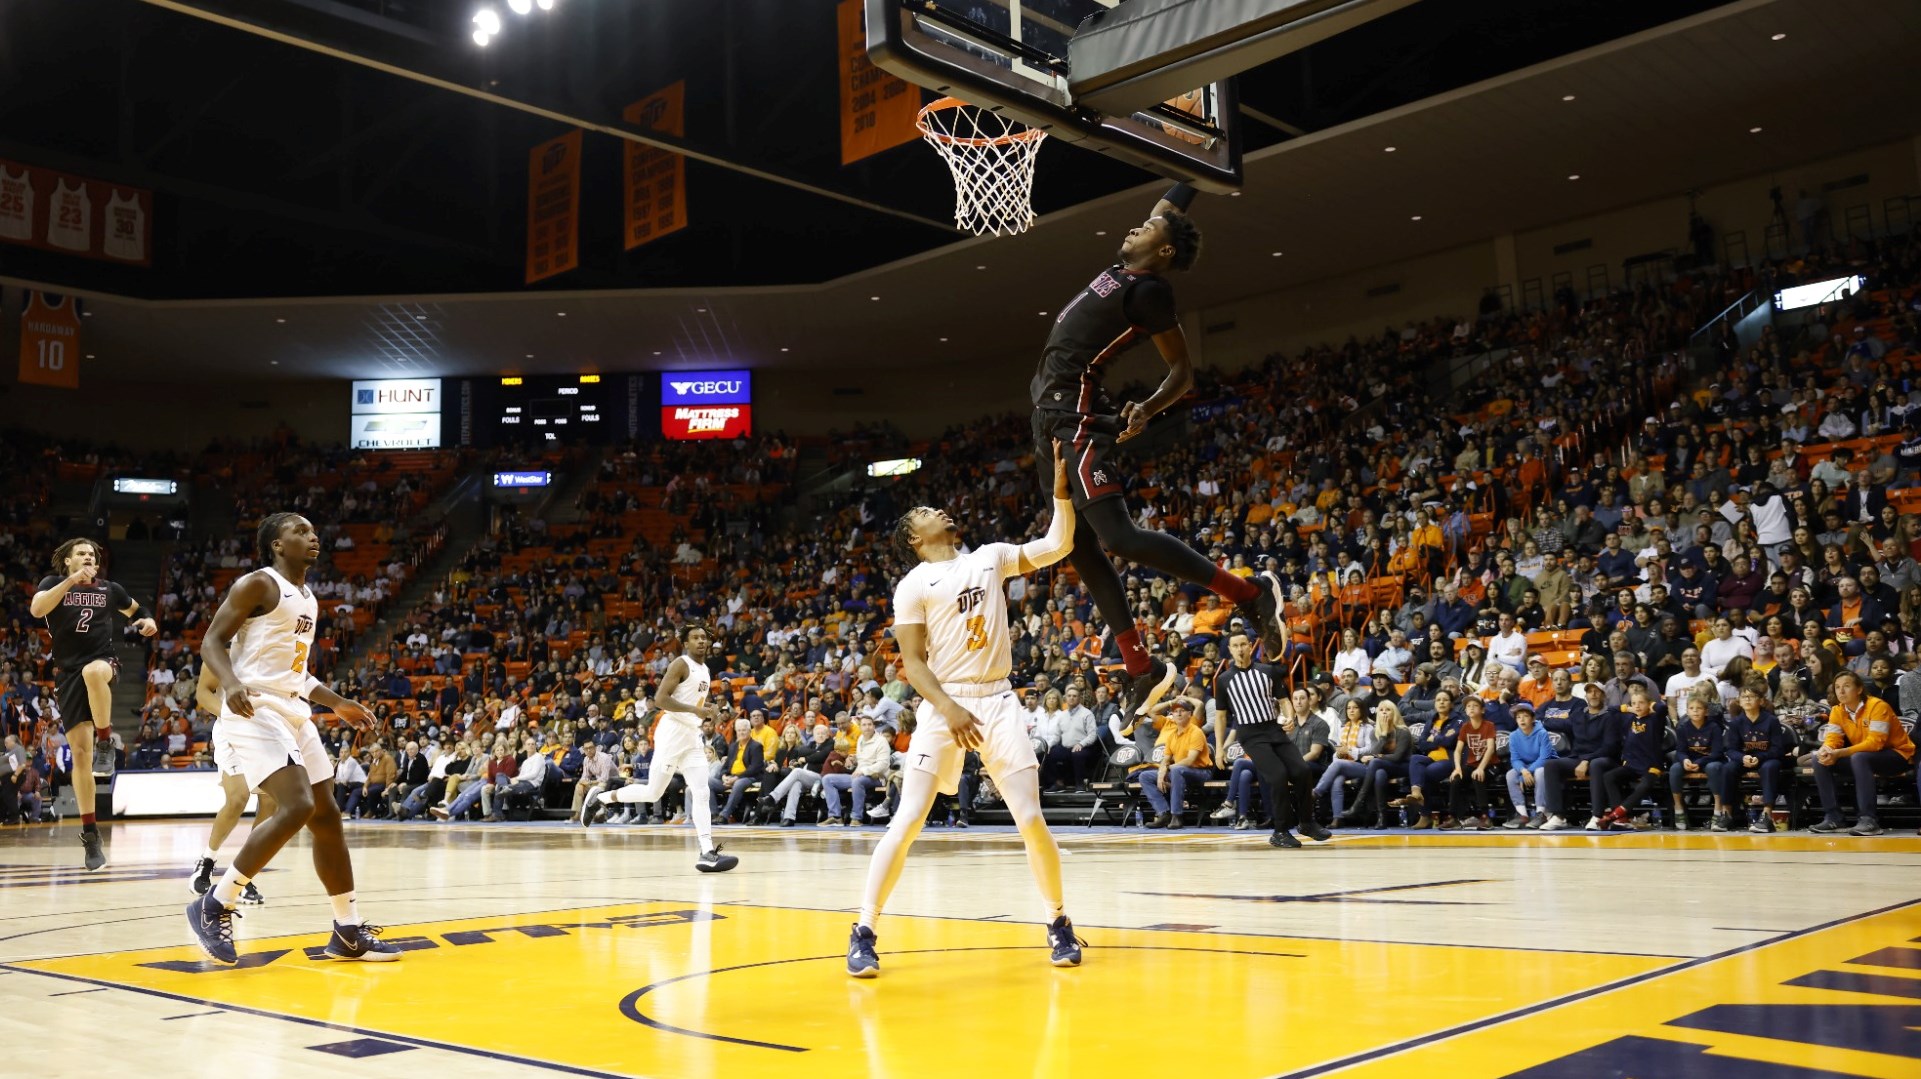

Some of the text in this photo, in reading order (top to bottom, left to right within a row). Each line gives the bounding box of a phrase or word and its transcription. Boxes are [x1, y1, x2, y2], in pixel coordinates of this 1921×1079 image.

[59, 206, 82, 225] 23
[38, 339, 64, 371] 10
[379, 388, 434, 403] HUNT
[691, 381, 740, 394] GECU
[581, 414, 600, 422] FOULS
[358, 439, 433, 448] CHEVROLET
[63, 592, 107, 608] AGGIES
[957, 586, 986, 614] UTEP
[75, 608, 94, 633] 2
[294, 614, 314, 635] UTEP
[966, 615, 988, 651] 3
[291, 640, 308, 674] 2
